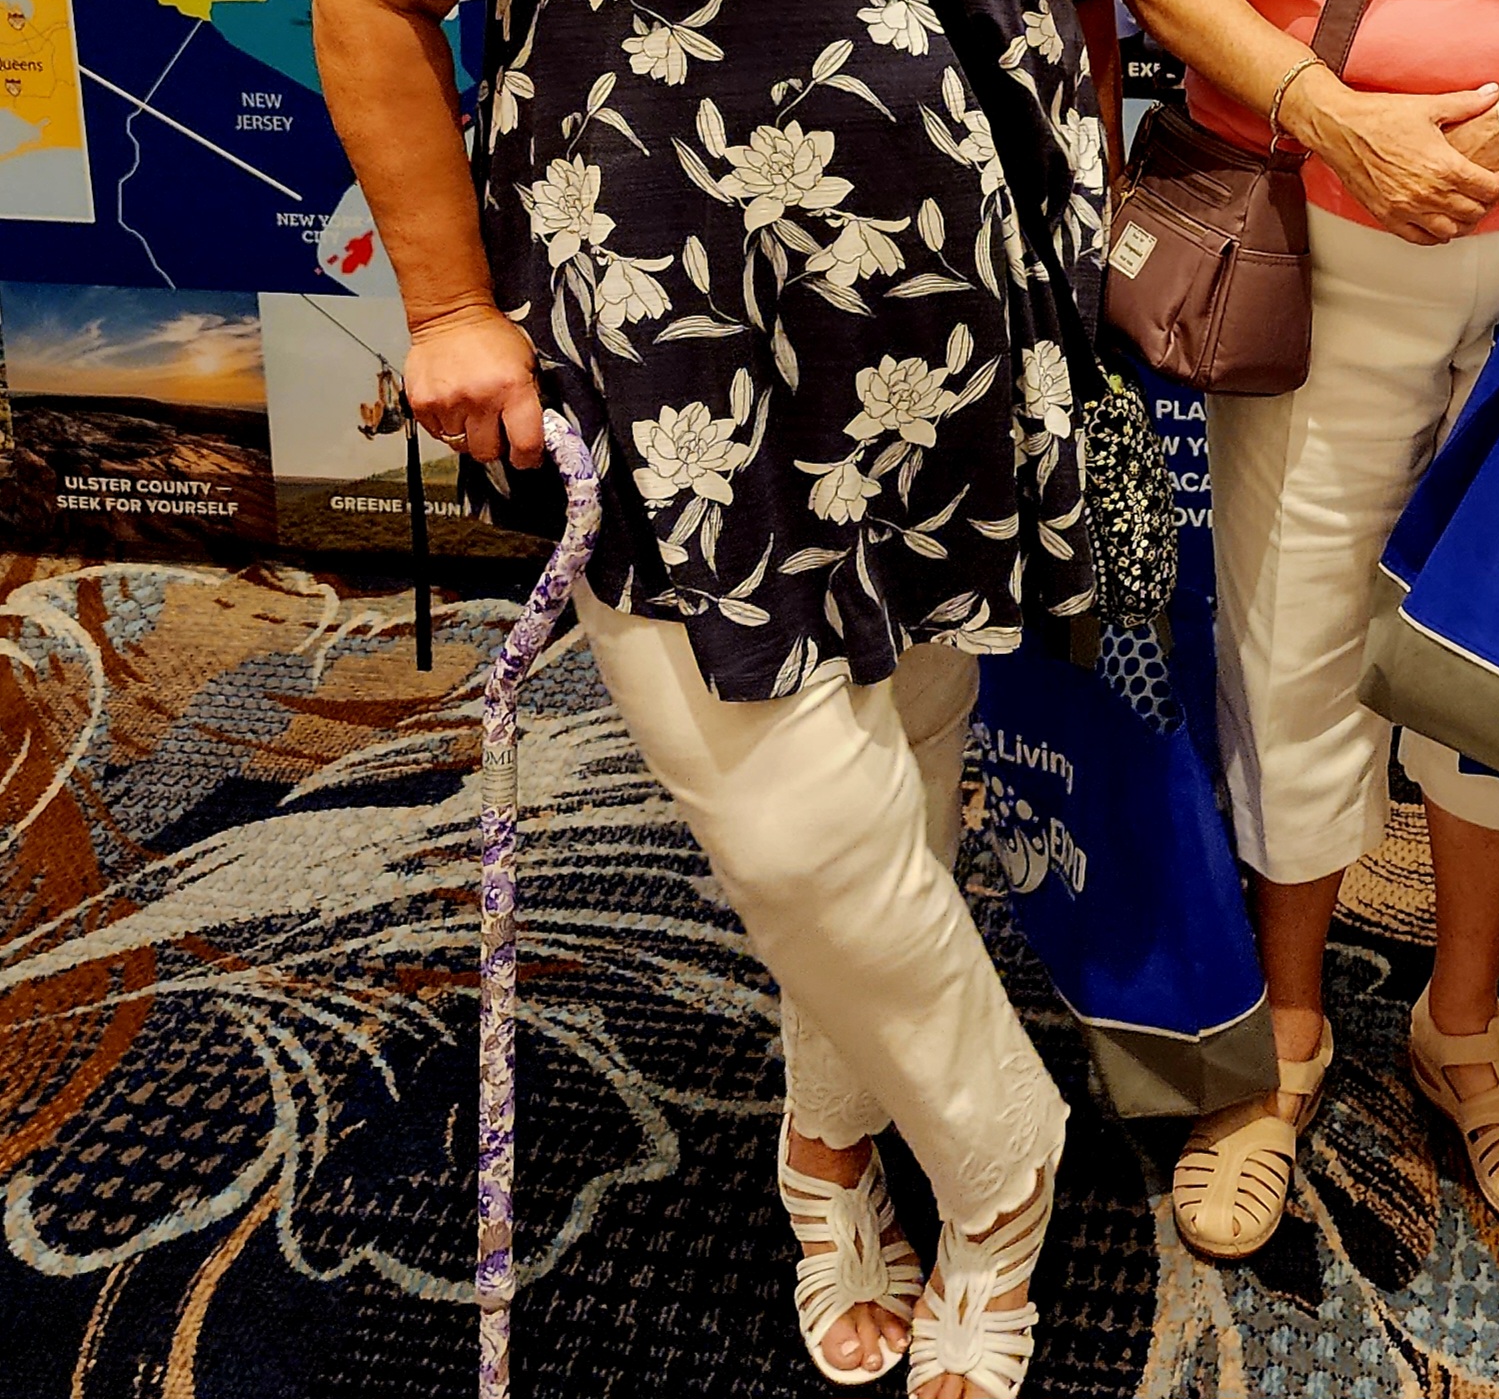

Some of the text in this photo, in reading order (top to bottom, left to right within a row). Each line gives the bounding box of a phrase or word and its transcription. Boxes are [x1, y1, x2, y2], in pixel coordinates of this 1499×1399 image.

[242, 92, 282, 108] NEW
[235, 115, 293, 132] JERSEY
[277, 213, 315, 228] NEW
[65, 476, 211, 497] ULSTER COUNTY
[57, 494, 239, 517] SEEK FOR YOURSELF
[330, 496, 403, 514] GREENE
